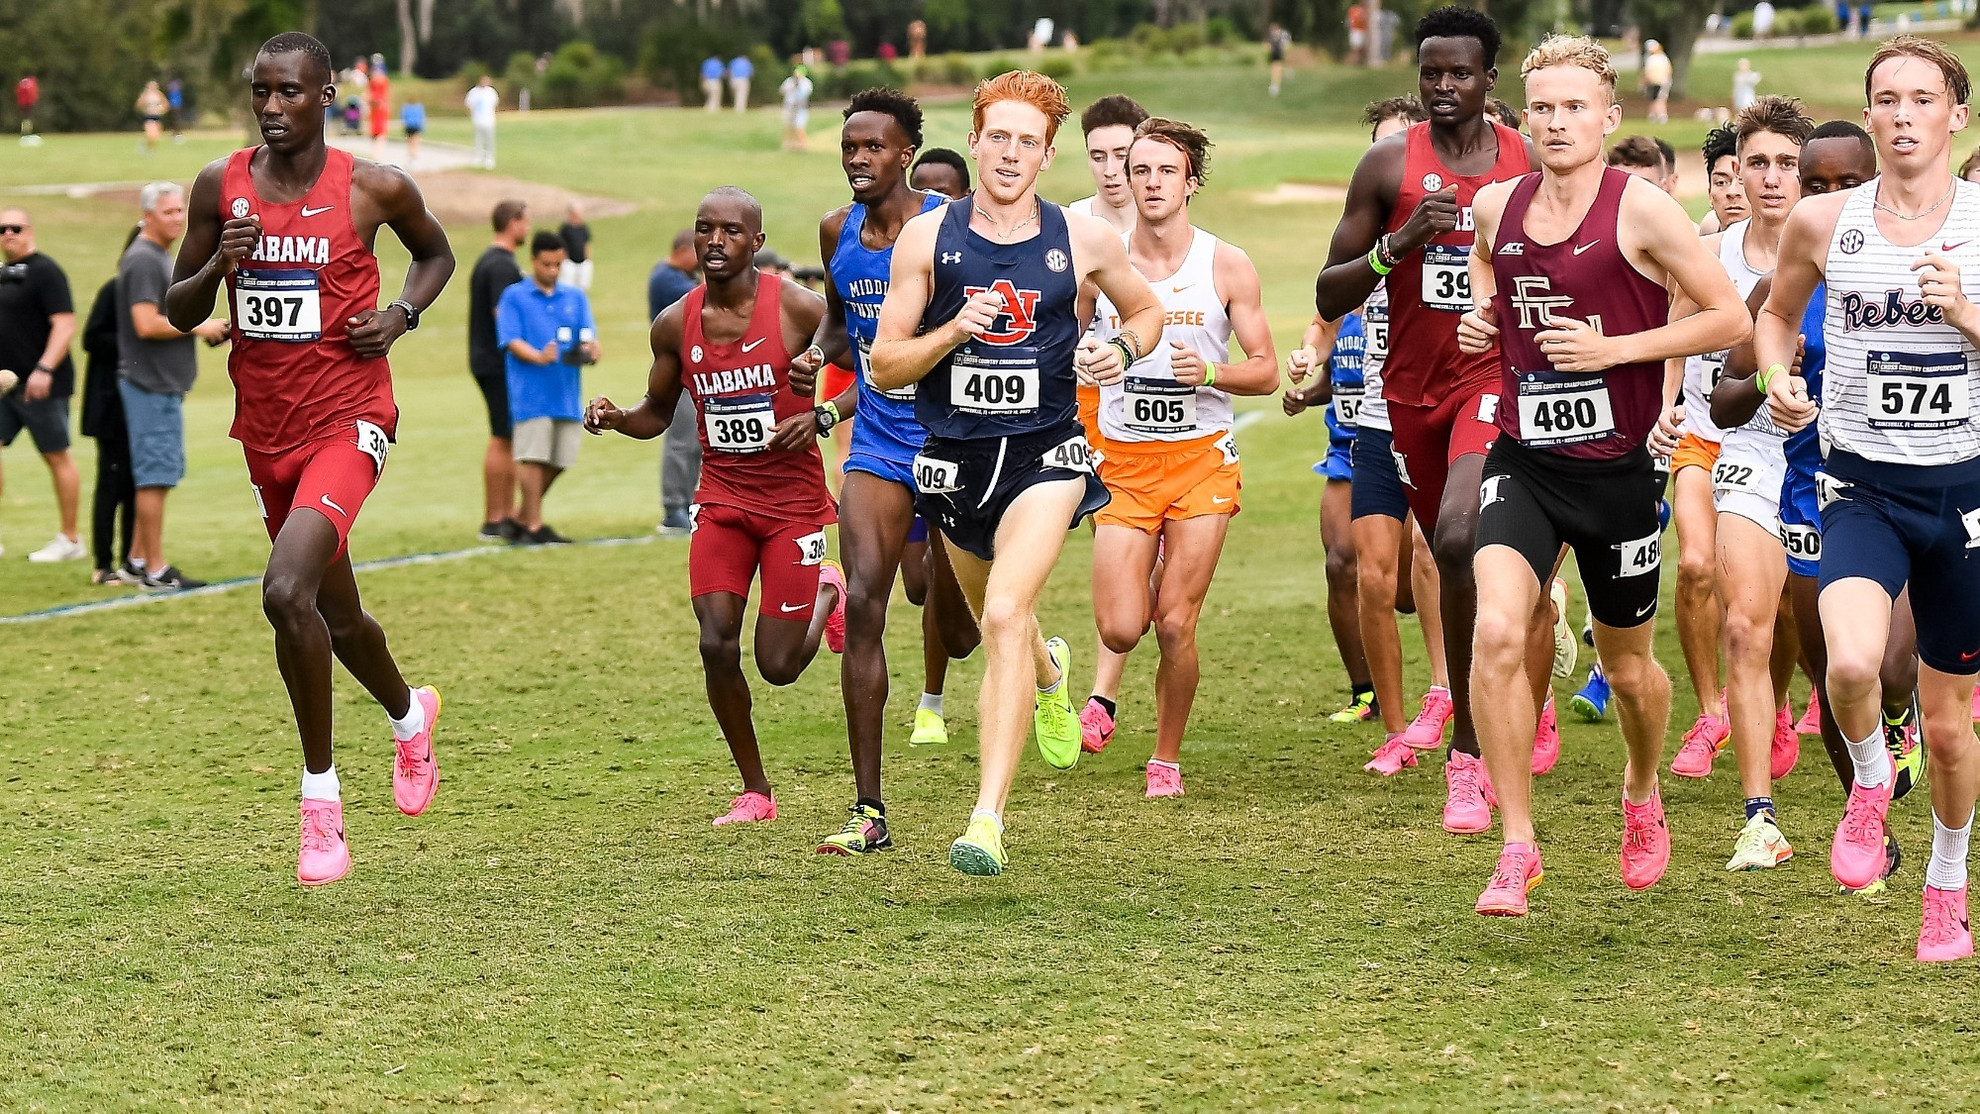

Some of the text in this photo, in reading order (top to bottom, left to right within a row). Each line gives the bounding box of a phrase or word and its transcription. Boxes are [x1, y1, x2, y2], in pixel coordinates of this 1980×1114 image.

[252, 235, 329, 264] ABAMA
[1498, 243, 1524, 255] ACC
[1840, 229, 1864, 254] SEC
[1045, 249, 1068, 273] SEC
[849, 279, 889, 298] MIDDL
[1436, 270, 1472, 298] 39
[246, 296, 303, 327] 397
[1109, 311, 1205, 330] TSSEE
[1336, 335, 1366, 352] MIDDL
[692, 364, 776, 395] ALABAMA
[1922, 364, 1965, 372] CHAMPIONSHIPS
[964, 374, 1025, 404] 409
[1564, 378, 1603, 388] CHAMPIONSHIPS
[1134, 398, 1185, 423] 605
[1881, 382, 1952, 414] 574
[1533, 397, 1597, 432] 480
[714, 418, 764, 443] 389
[370, 430, 387, 460] 39
[1715, 463, 1753, 486] 522
